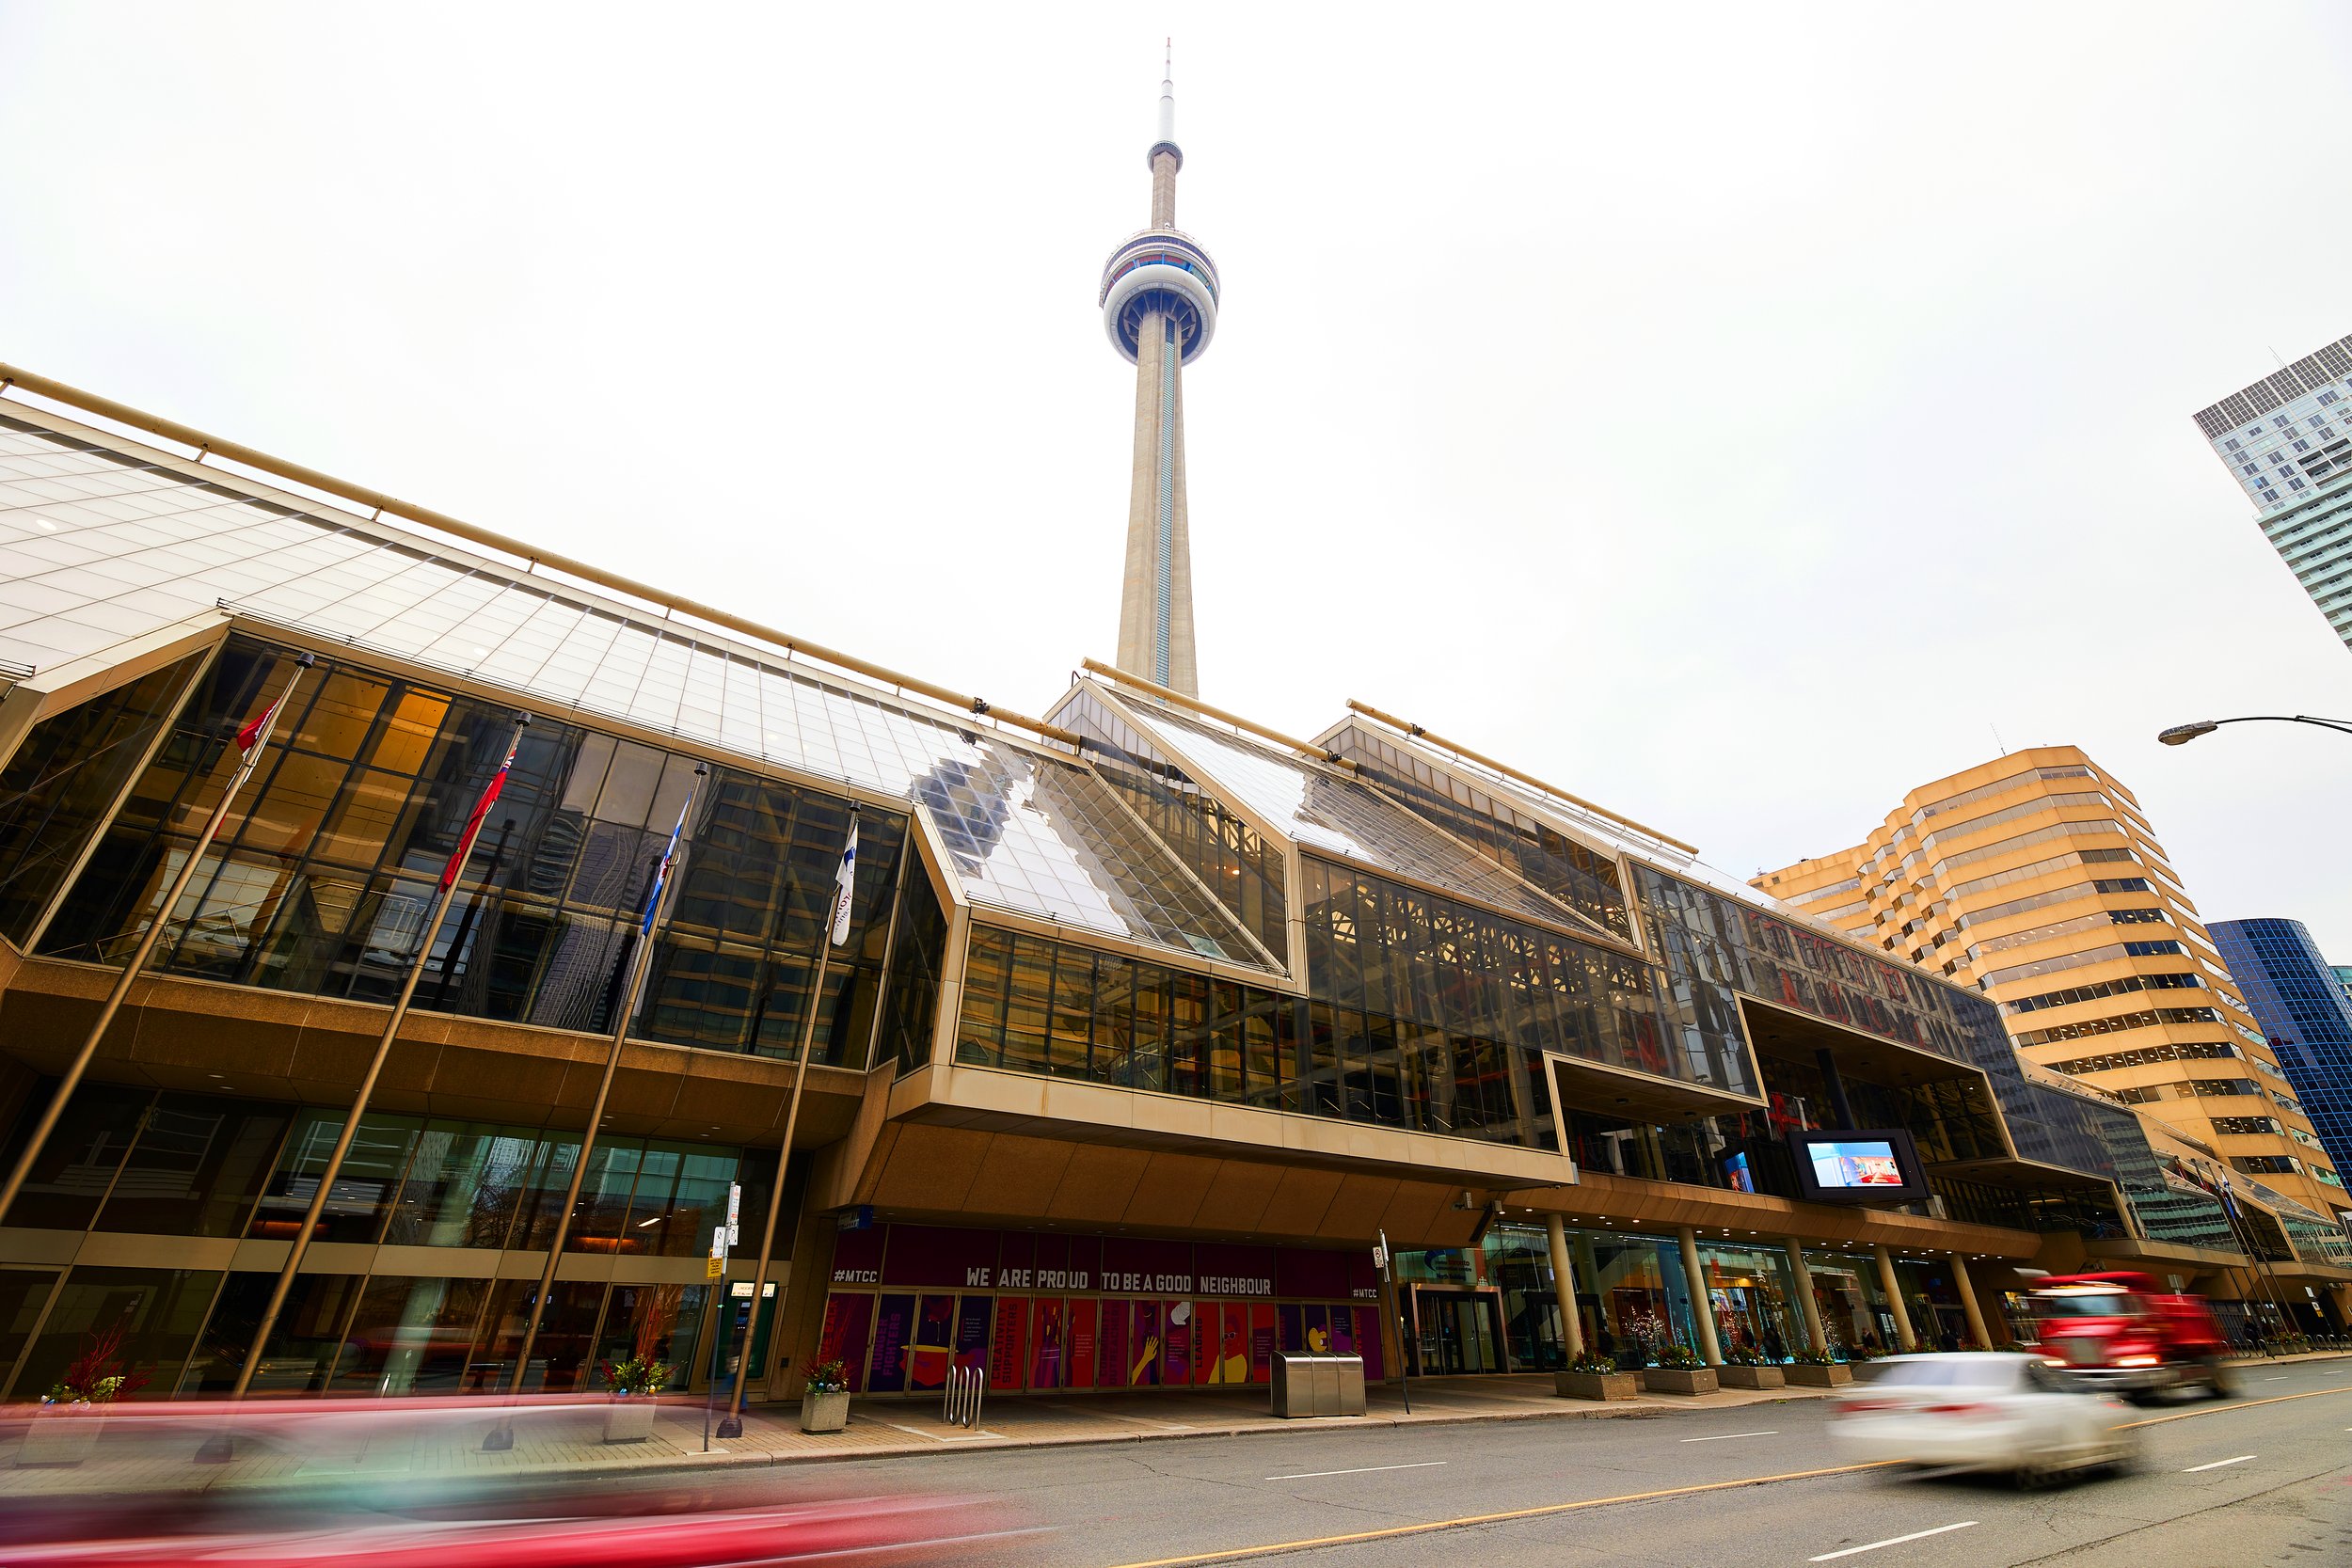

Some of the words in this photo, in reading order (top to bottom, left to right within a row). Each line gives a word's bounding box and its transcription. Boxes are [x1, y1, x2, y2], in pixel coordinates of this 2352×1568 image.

[834, 1270, 877, 1282] #MTCC
[967, 1268, 991, 1286] WE
[999, 1269, 1031, 1287] ARE
[1038, 1271, 1089, 1289] PROUD
[1102, 1273, 1120, 1290] TO
[1123, 1274, 1140, 1290] BE
[1143, 1275, 1152, 1291] A
[1156, 1275, 1192, 1292] GOOD
[1200, 1277, 1270, 1294] NEIGHBOUR
[1353, 1289, 1377, 1298] #MTCC
[871, 1317, 888, 1370] HUNGER
[882, 1311, 901, 1376] FIGHTERS
[991, 1307, 1008, 1379] CREATIVITY
[1002, 1302, 1018, 1384] SUPPORTERS
[1195, 1318, 1203, 1368] LEADERS
